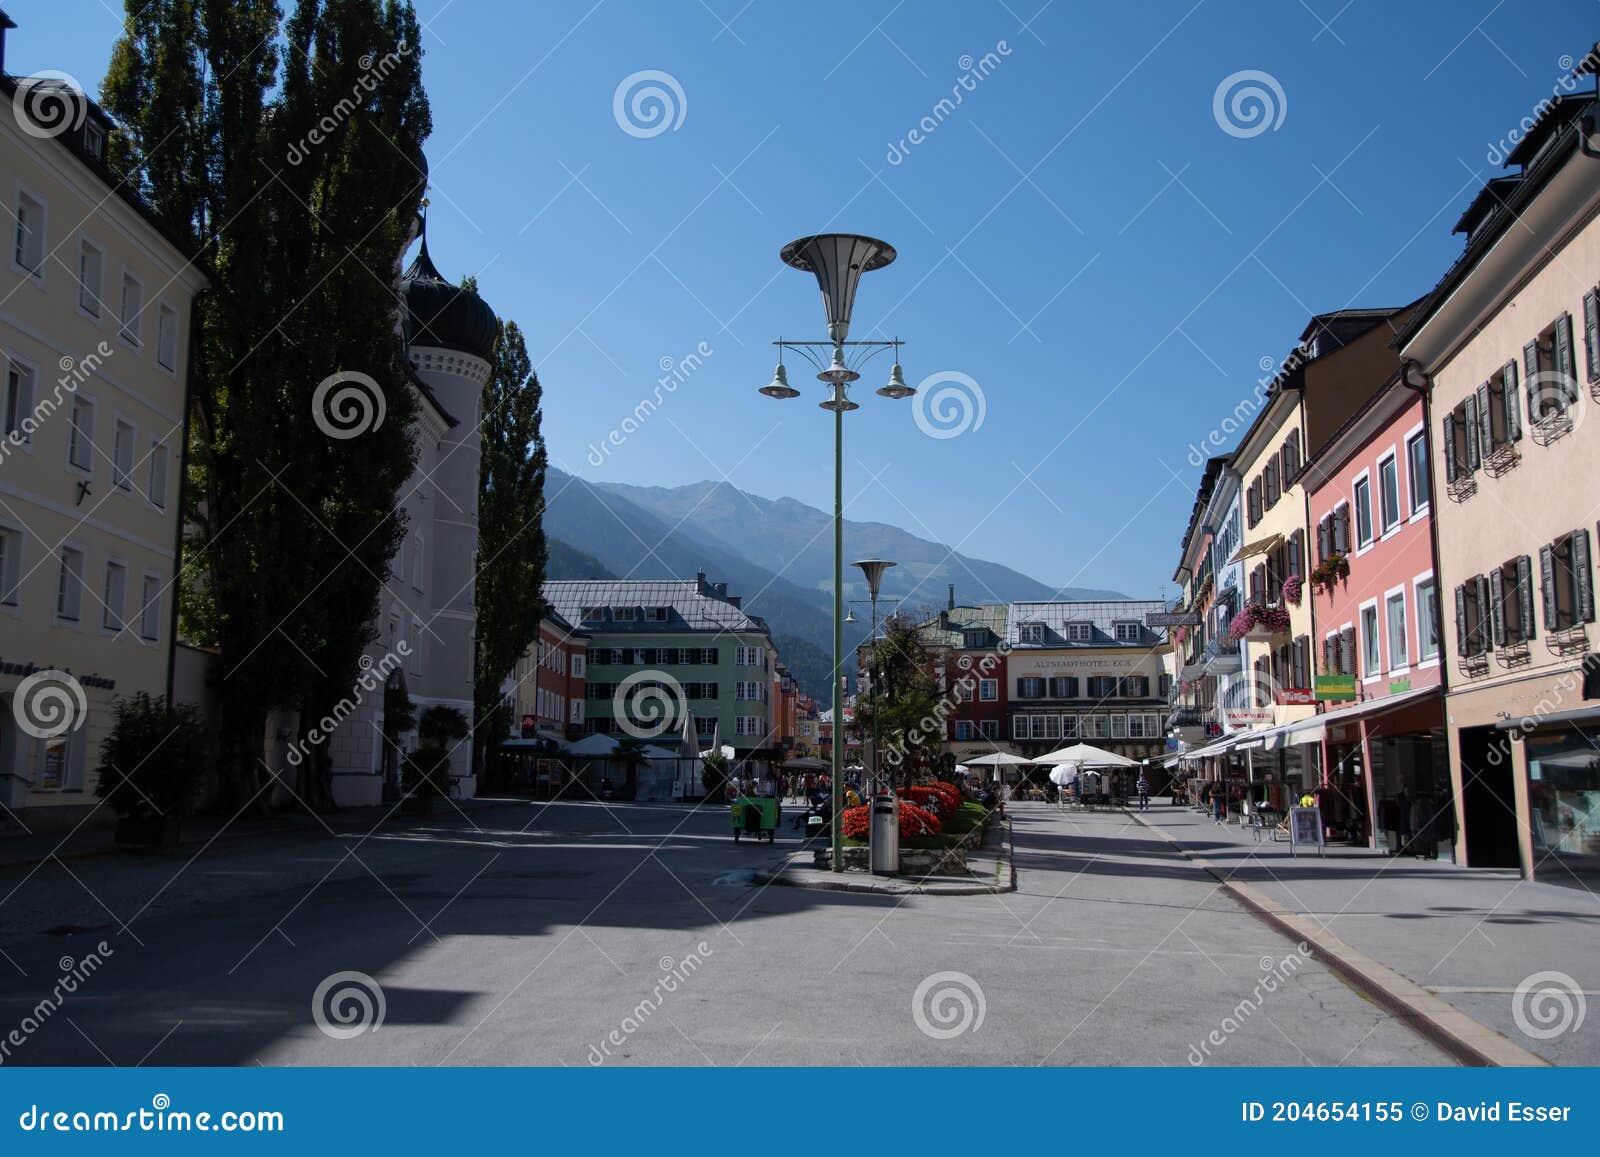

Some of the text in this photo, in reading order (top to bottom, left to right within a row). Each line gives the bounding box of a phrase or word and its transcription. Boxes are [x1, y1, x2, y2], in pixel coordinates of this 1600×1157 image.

[1034, 659, 1132, 669] ALTSTADTHOTEL ECK
[79, 672, 116, 690] reisen
